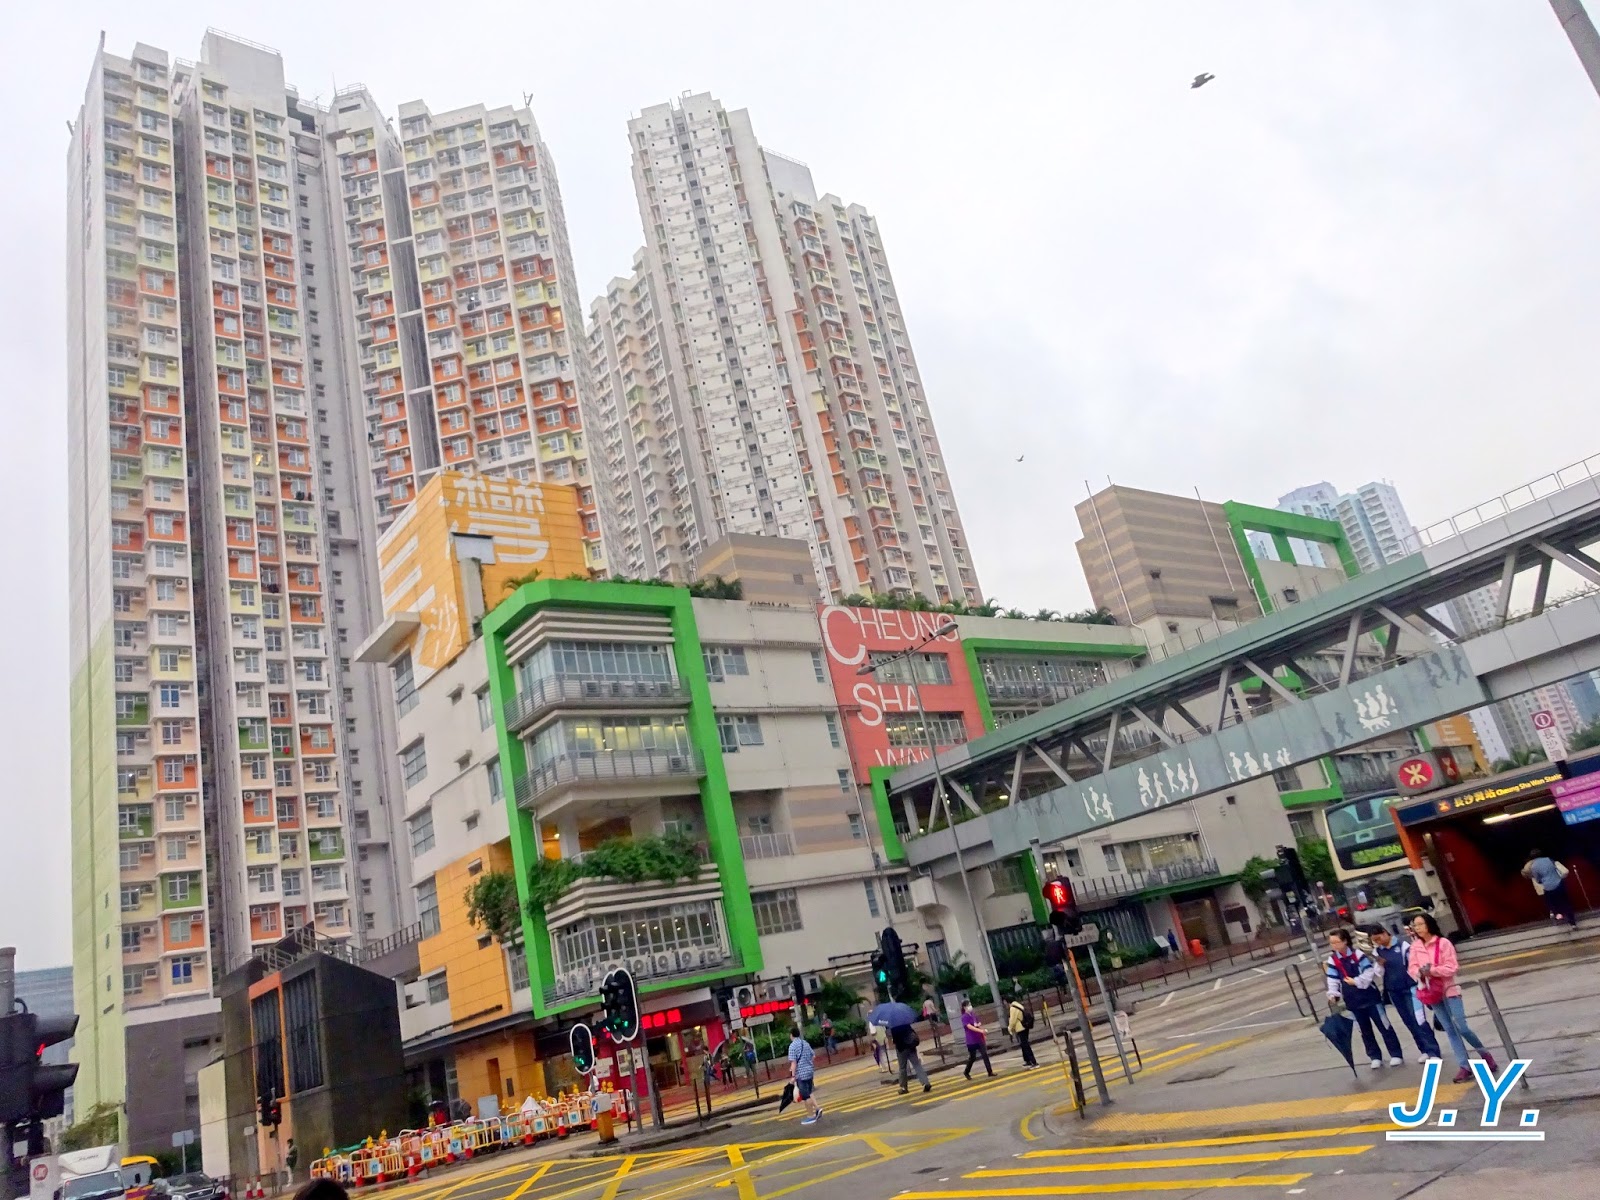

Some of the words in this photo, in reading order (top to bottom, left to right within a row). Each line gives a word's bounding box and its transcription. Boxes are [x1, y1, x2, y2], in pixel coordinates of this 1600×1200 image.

[820, 605, 959, 666] CHEUNG
[853, 682, 925, 726] SHA
[1495, 785, 1520, 796] Cheung
[1519, 782, 1532, 790] Sha
[1530, 779, 1546, 787] Wan
